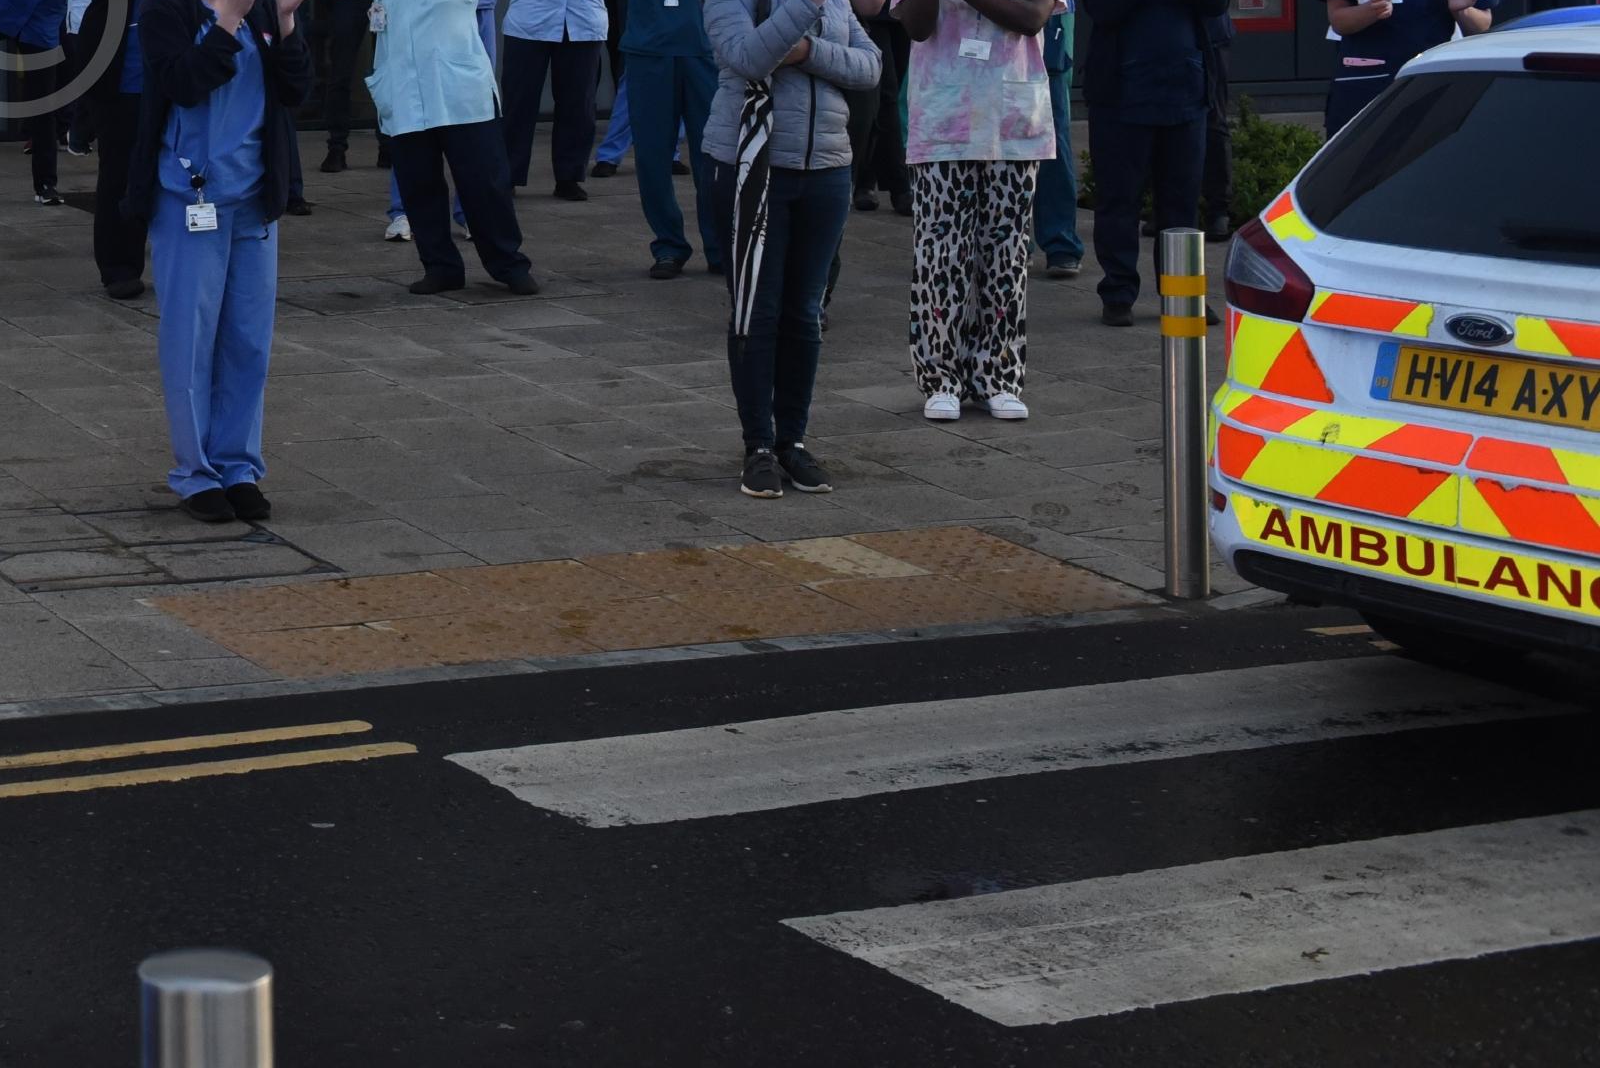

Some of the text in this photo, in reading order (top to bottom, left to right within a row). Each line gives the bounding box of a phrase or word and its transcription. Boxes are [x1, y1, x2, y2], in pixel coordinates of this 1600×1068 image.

[1456, 319, 1496, 341] Ford
[1405, 353, 1600, 421] HV14 AXY
[1259, 508, 1600, 610] AMBULAN
